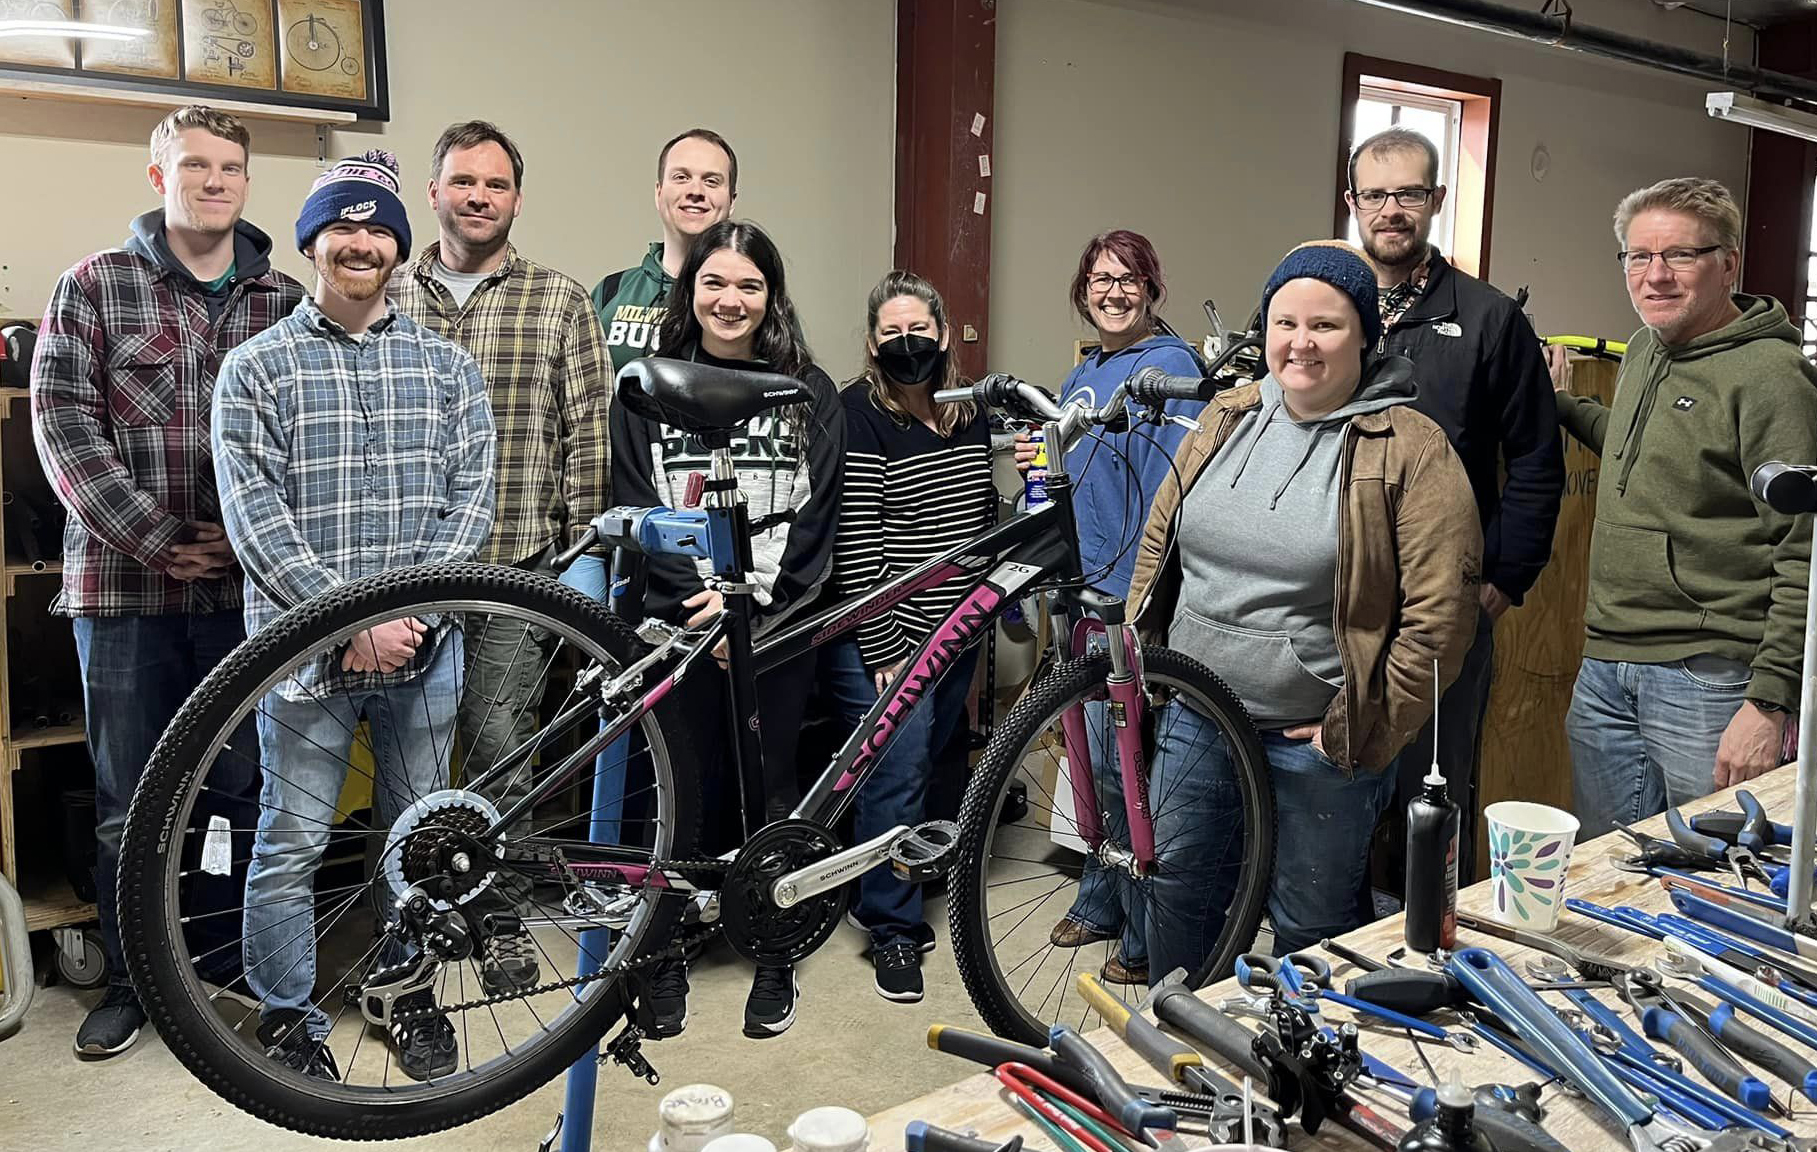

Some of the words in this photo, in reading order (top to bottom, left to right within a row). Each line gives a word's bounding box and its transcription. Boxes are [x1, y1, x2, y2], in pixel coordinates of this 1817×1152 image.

[612, 304, 670, 324] MILW
[1564, 468, 1597, 497] OVE
[811, 583, 906, 646] SIDEWINDER
[847, 599, 989, 776] SCHWINN
[157, 771, 192, 854] SCHWINN
[820, 861, 859, 881] SCHWINN
